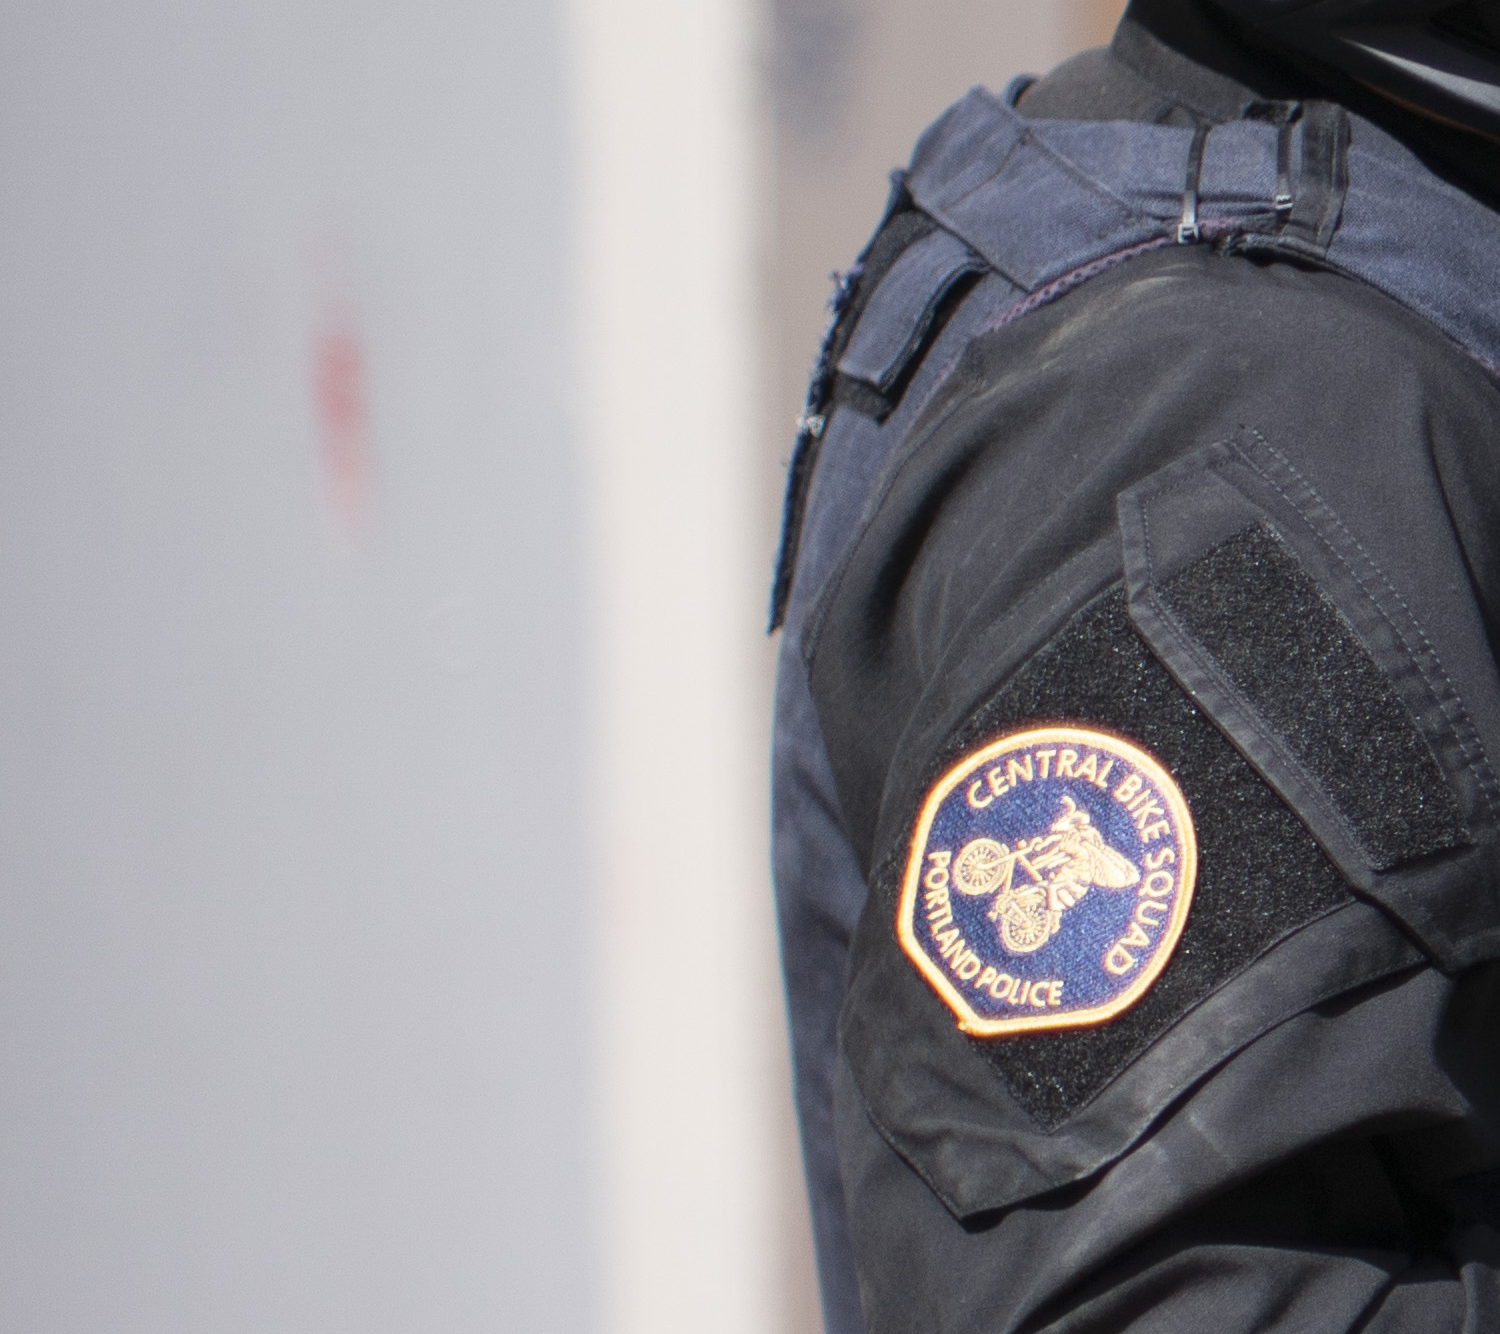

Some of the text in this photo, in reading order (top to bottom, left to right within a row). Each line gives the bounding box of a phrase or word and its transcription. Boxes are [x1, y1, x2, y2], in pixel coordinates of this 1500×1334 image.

[923, 850, 1064, 1007] PORTLAND POLICE
[966, 748, 1175, 976] CENTRAL BIKE SQUAD
